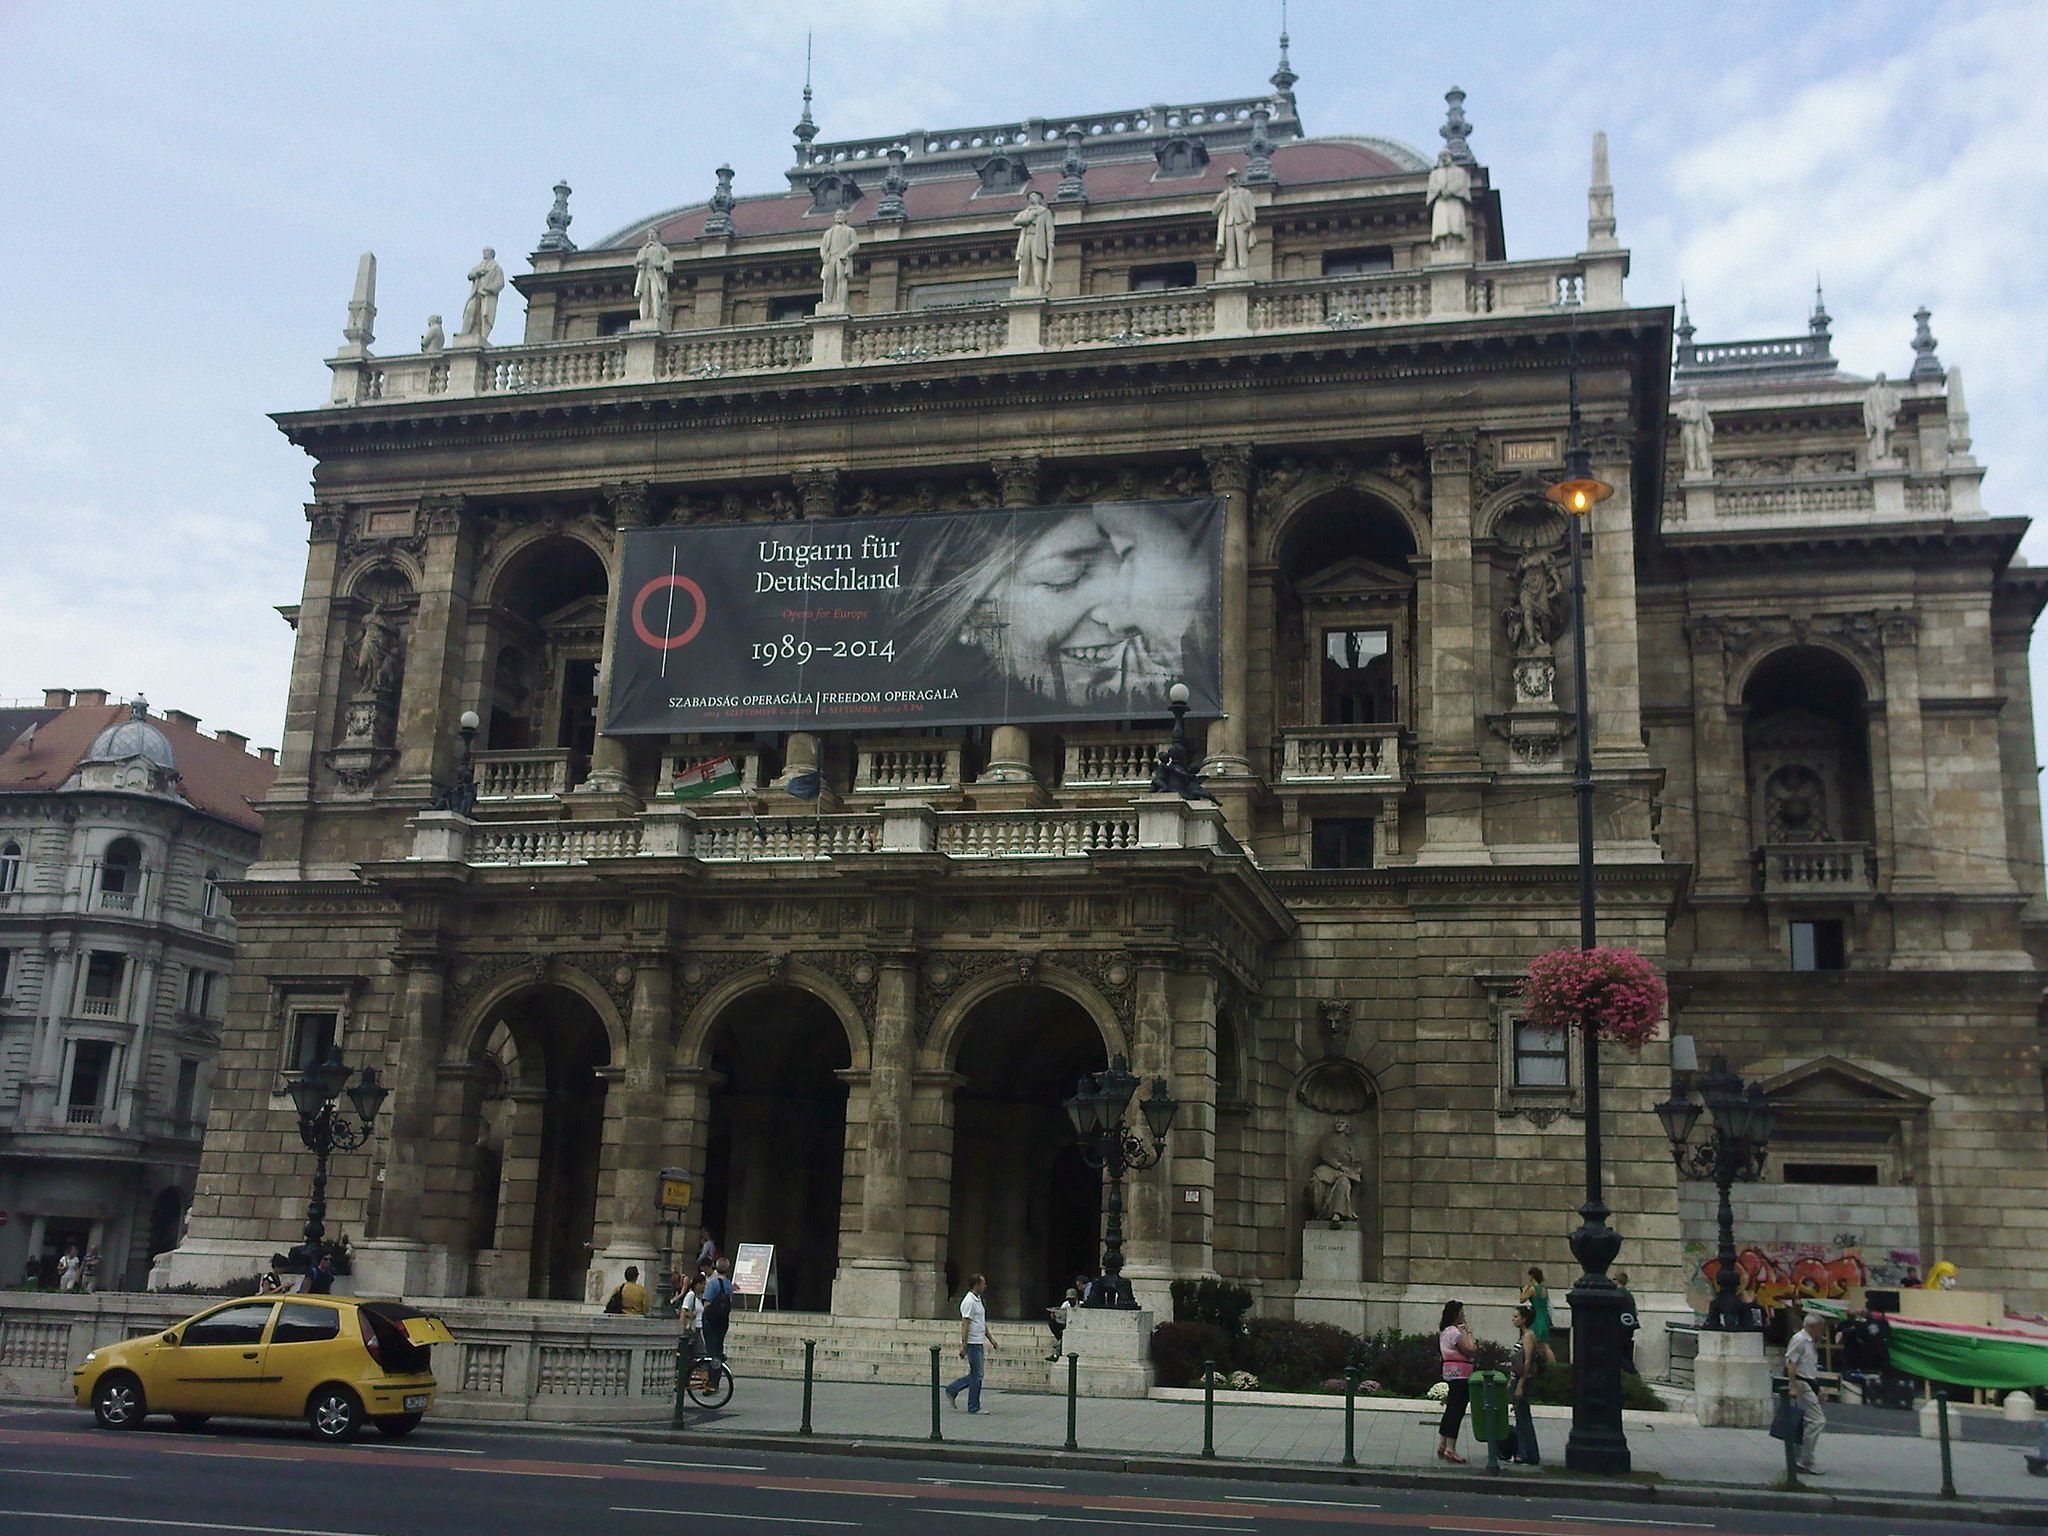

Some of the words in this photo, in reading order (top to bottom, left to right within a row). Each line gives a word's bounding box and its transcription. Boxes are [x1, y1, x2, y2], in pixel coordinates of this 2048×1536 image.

[759, 541, 852, 568] Ungarn
[861, 535, 900, 559] für
[755, 565, 900, 593] Deutschland
[668, 694, 739, 708] SZABADSÁG
[742, 691, 813, 706] OPERAGÁLA
[822, 691, 880, 703] FREEDOM
[884, 688, 959, 701] OPERAGALA
